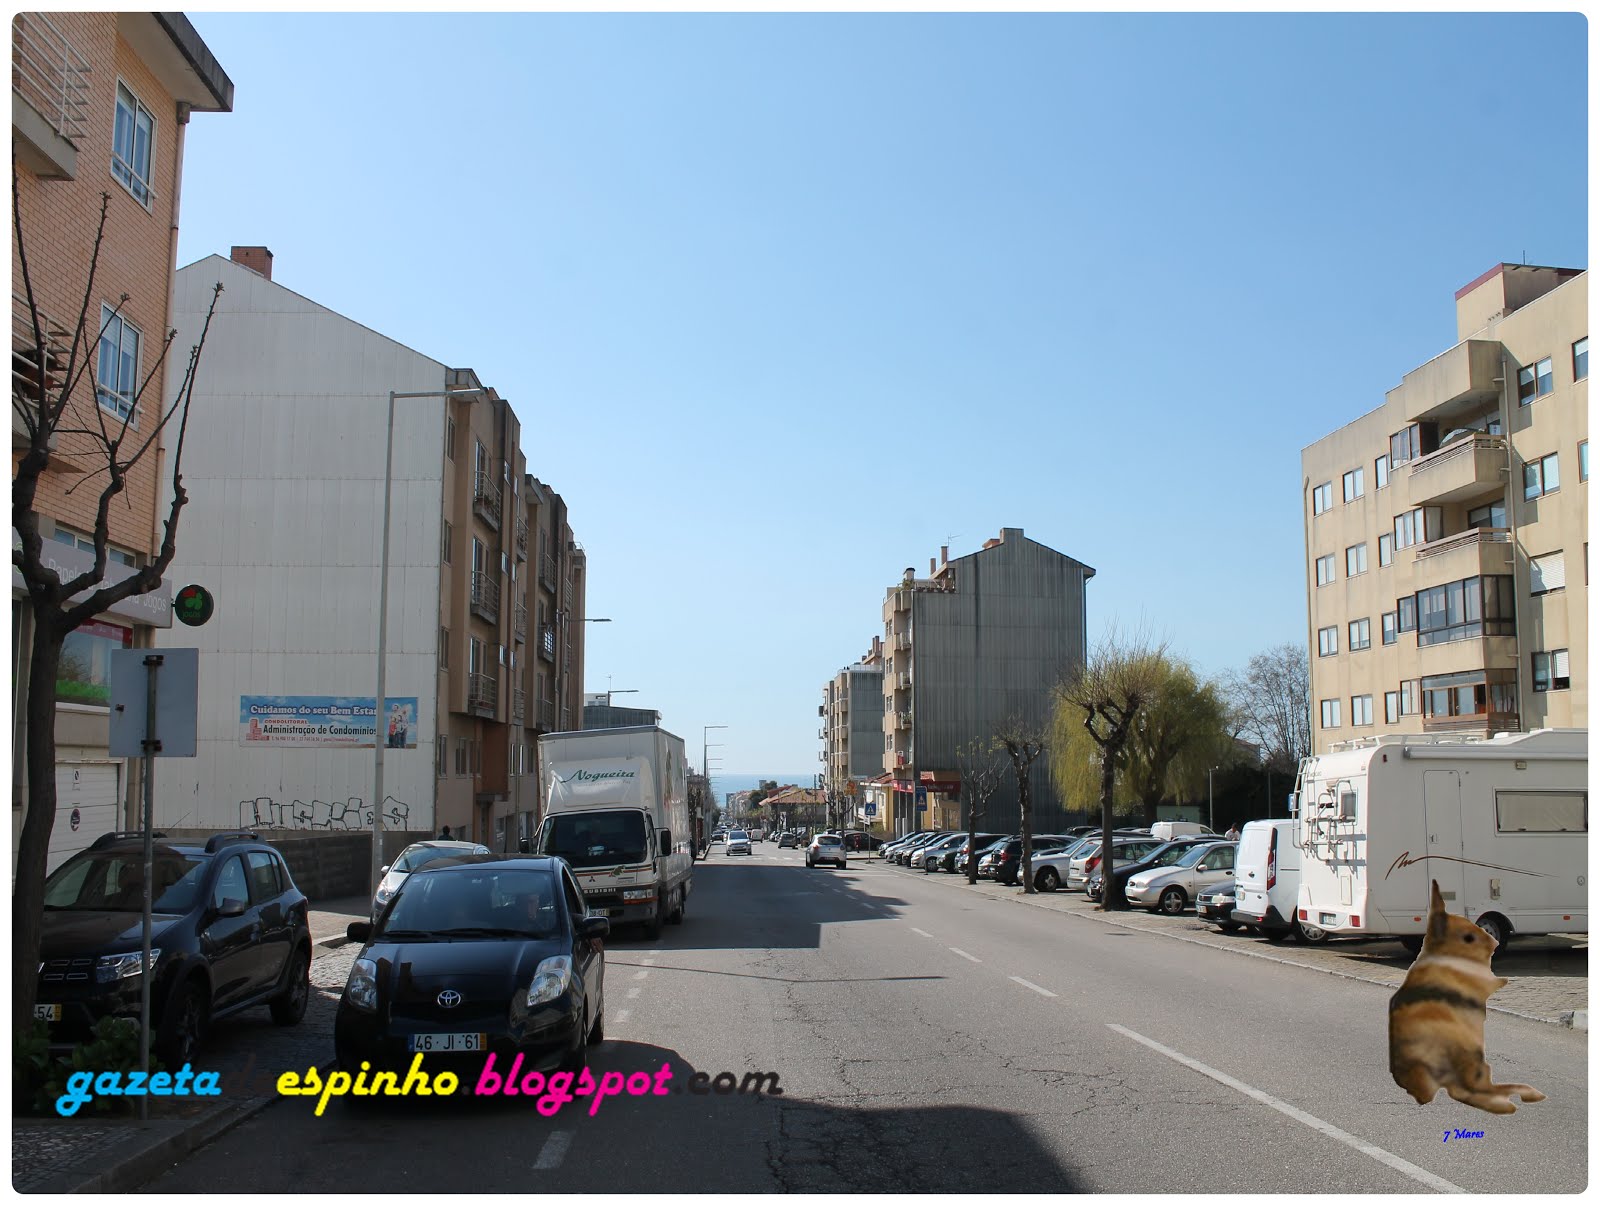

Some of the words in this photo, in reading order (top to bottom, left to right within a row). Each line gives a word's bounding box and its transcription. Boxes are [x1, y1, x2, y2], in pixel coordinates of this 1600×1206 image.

[250, 704, 297, 715] Cuidamos
[298, 705, 311, 714] do
[312, 707, 329, 715] seu
[330, 705, 351, 715] Bem
[263, 724, 316, 736] Administração
[317, 726, 327, 735] de
[561, 769, 635, 783] Nogueira
